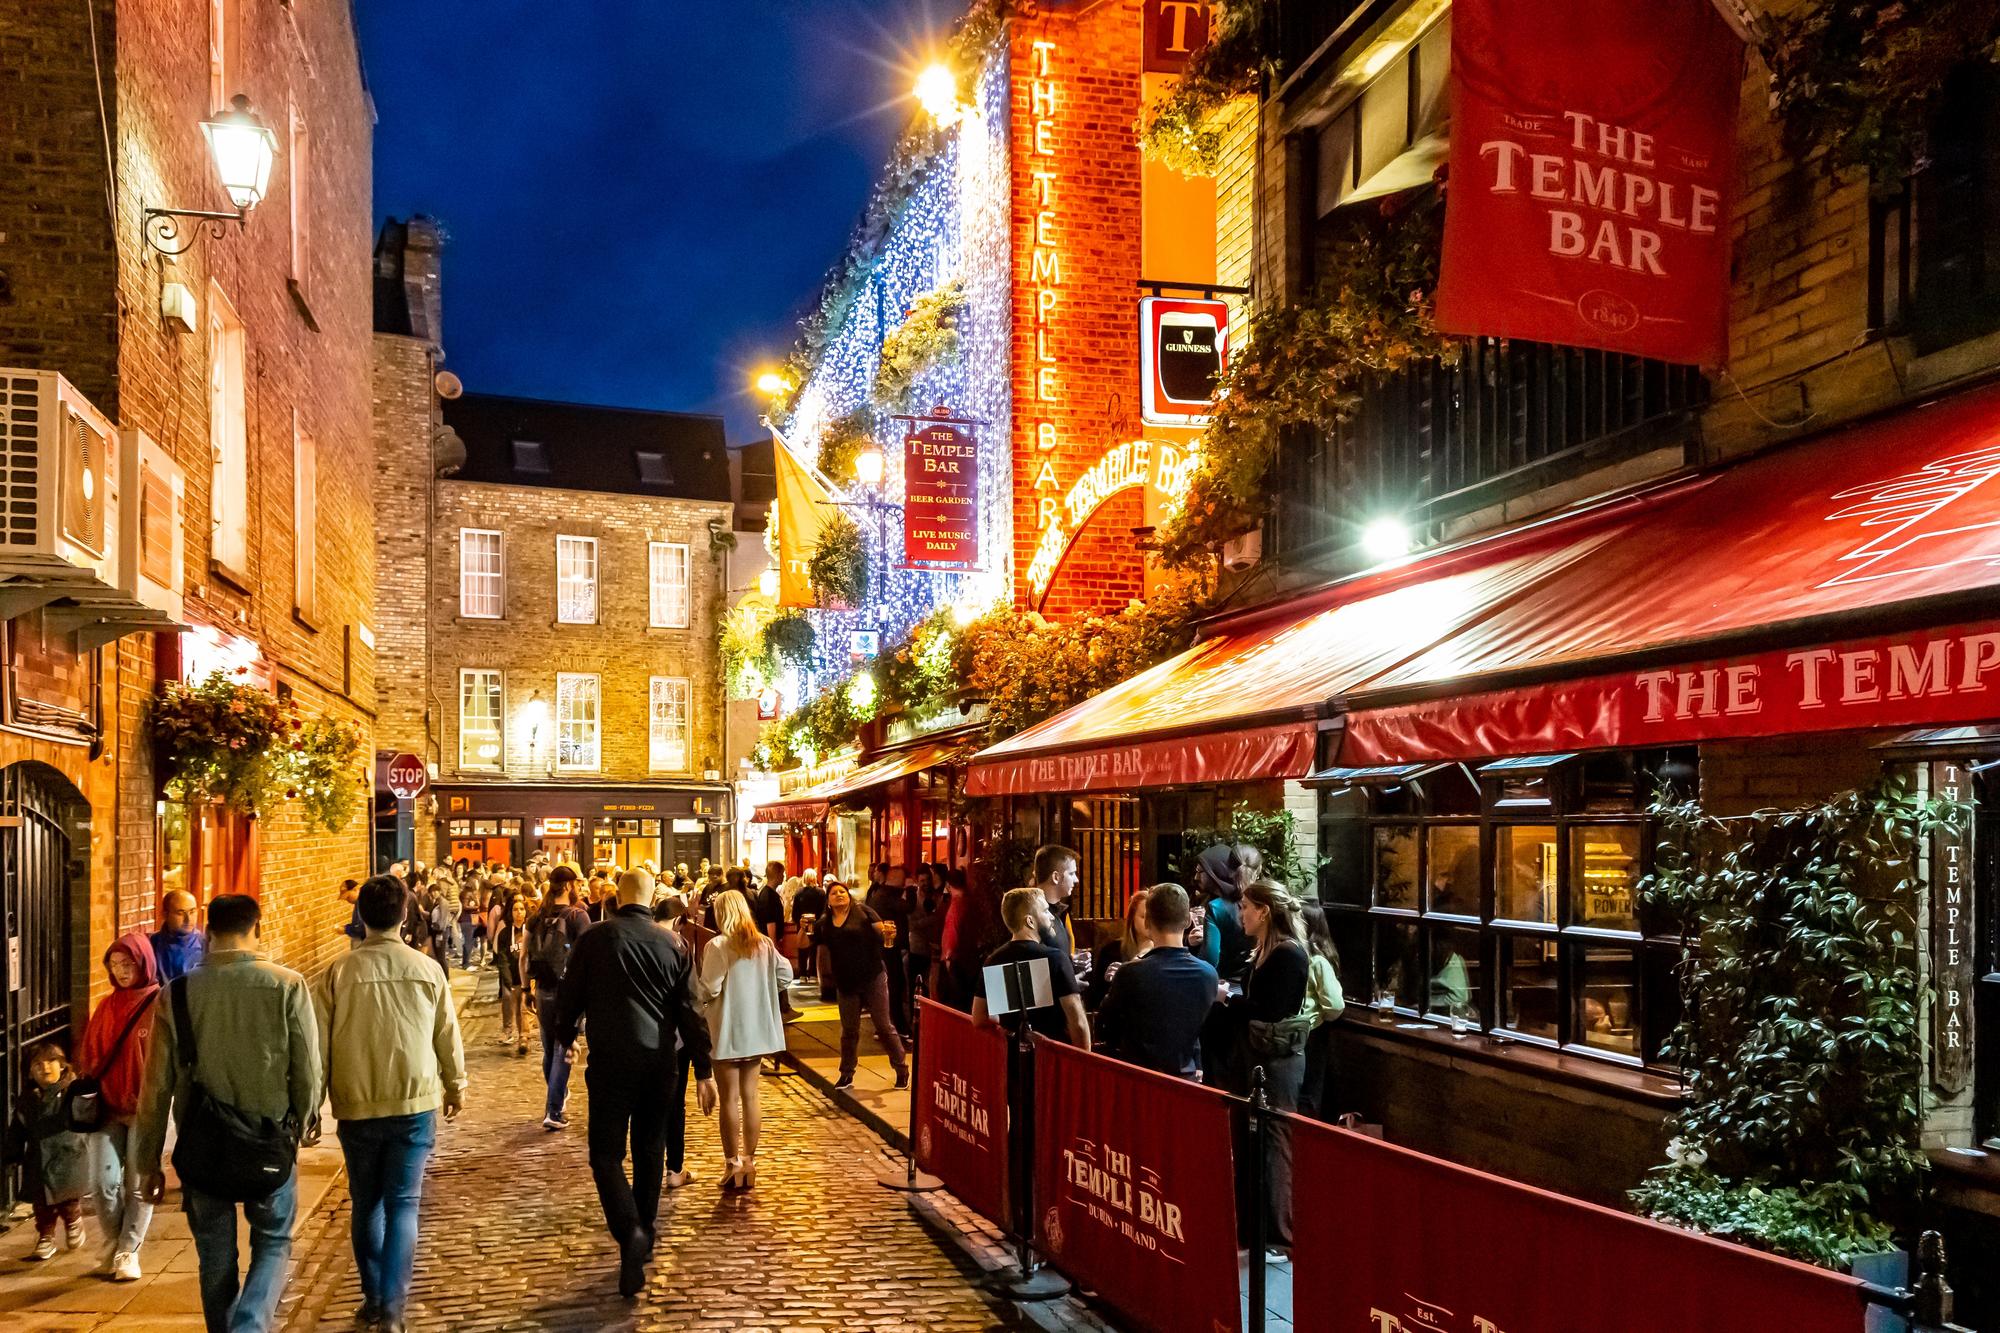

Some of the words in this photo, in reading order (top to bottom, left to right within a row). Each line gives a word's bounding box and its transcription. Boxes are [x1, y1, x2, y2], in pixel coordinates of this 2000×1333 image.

[1032, 41, 1056, 155] THE
[1503, 114, 1542, 131] TRADE
[1563, 110, 1656, 169] THE
[1478, 140, 1721, 235] TEMPLE
[1548, 209, 1670, 278] BAR
[1031, 172, 1060, 403] TEMPLE
[1165, 343, 1212, 354] GUINNESS
[908, 440, 975, 458] TEMPLE
[930, 432, 954, 441] THE
[924, 458, 960, 474] BAR
[1033, 423, 1060, 529] BAR
[910, 495, 934, 504] BEER
[935, 496, 973, 505] GARDEN
[912, 530, 937, 539] LIVE
[938, 531, 972, 540] MUSIC
[926, 542, 957, 551] DAILY
[1635, 664, 1763, 724] THE
[390, 768, 423, 783] STOP
[1030, 759, 1056, 783] THE
[1059, 753, 1109, 781] TEMPLE
[1113, 748, 1144, 776] BAR
[1946, 845, 1961, 966] TEMPLE
[1947, 989, 1961, 1049] BAR
[1138, 1190, 1185, 1244] BAR
[1417, 1307, 1438, 1324] Est.
